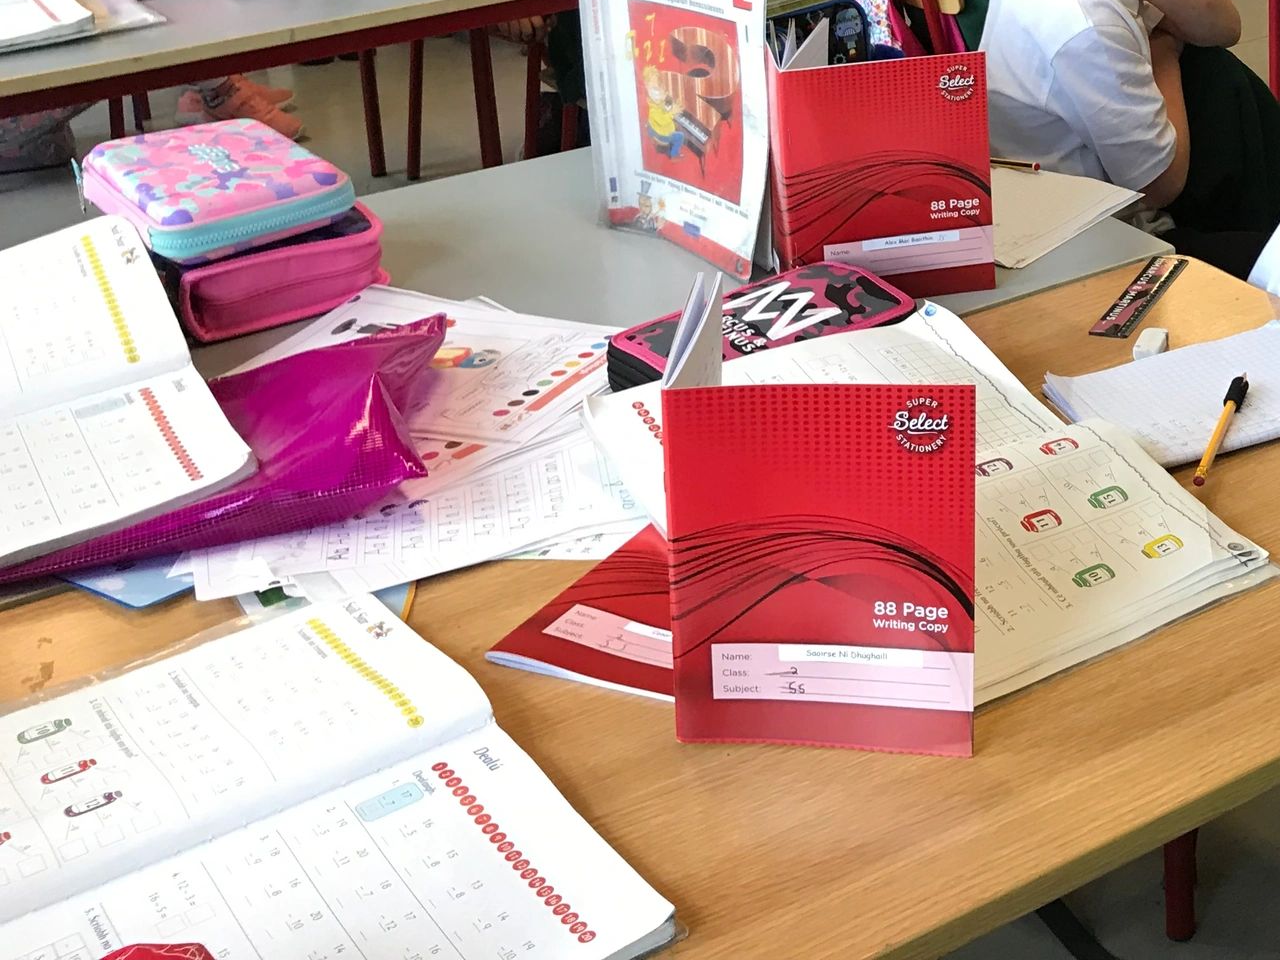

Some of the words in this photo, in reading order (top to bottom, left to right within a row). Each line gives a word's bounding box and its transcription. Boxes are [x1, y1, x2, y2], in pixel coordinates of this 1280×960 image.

[947, 65, 968, 73] SUPER
[937, 74, 975, 89] Select
[941, 87, 974, 102] STATIONERY
[930, 201, 945, 211] 88
[950, 198, 980, 210] Page
[930, 210, 958, 219] Writing
[960, 208, 980, 216] Copy
[1106, 290, 1137, 320] MARTINUS
[906, 398, 938, 408] SUPER
[892, 411, 949, 430] Select
[896, 434, 946, 452] STATIONERY
[1102, 494, 1117, 504] 15
[1036, 518, 1049, 529] 11
[1156, 544, 1171, 553] 13
[1088, 571, 1103, 583] 10
[874, 601, 897, 615] 88
[903, 603, 949, 619] Page
[873, 619, 915, 632] Writing
[918, 622, 949, 633] Copy
[722, 653, 752, 661] Name:
[806, 650, 836, 658] Saoirse
[850, 650, 888, 661] Dhughaill
[473, 746, 503, 772] Dealú
